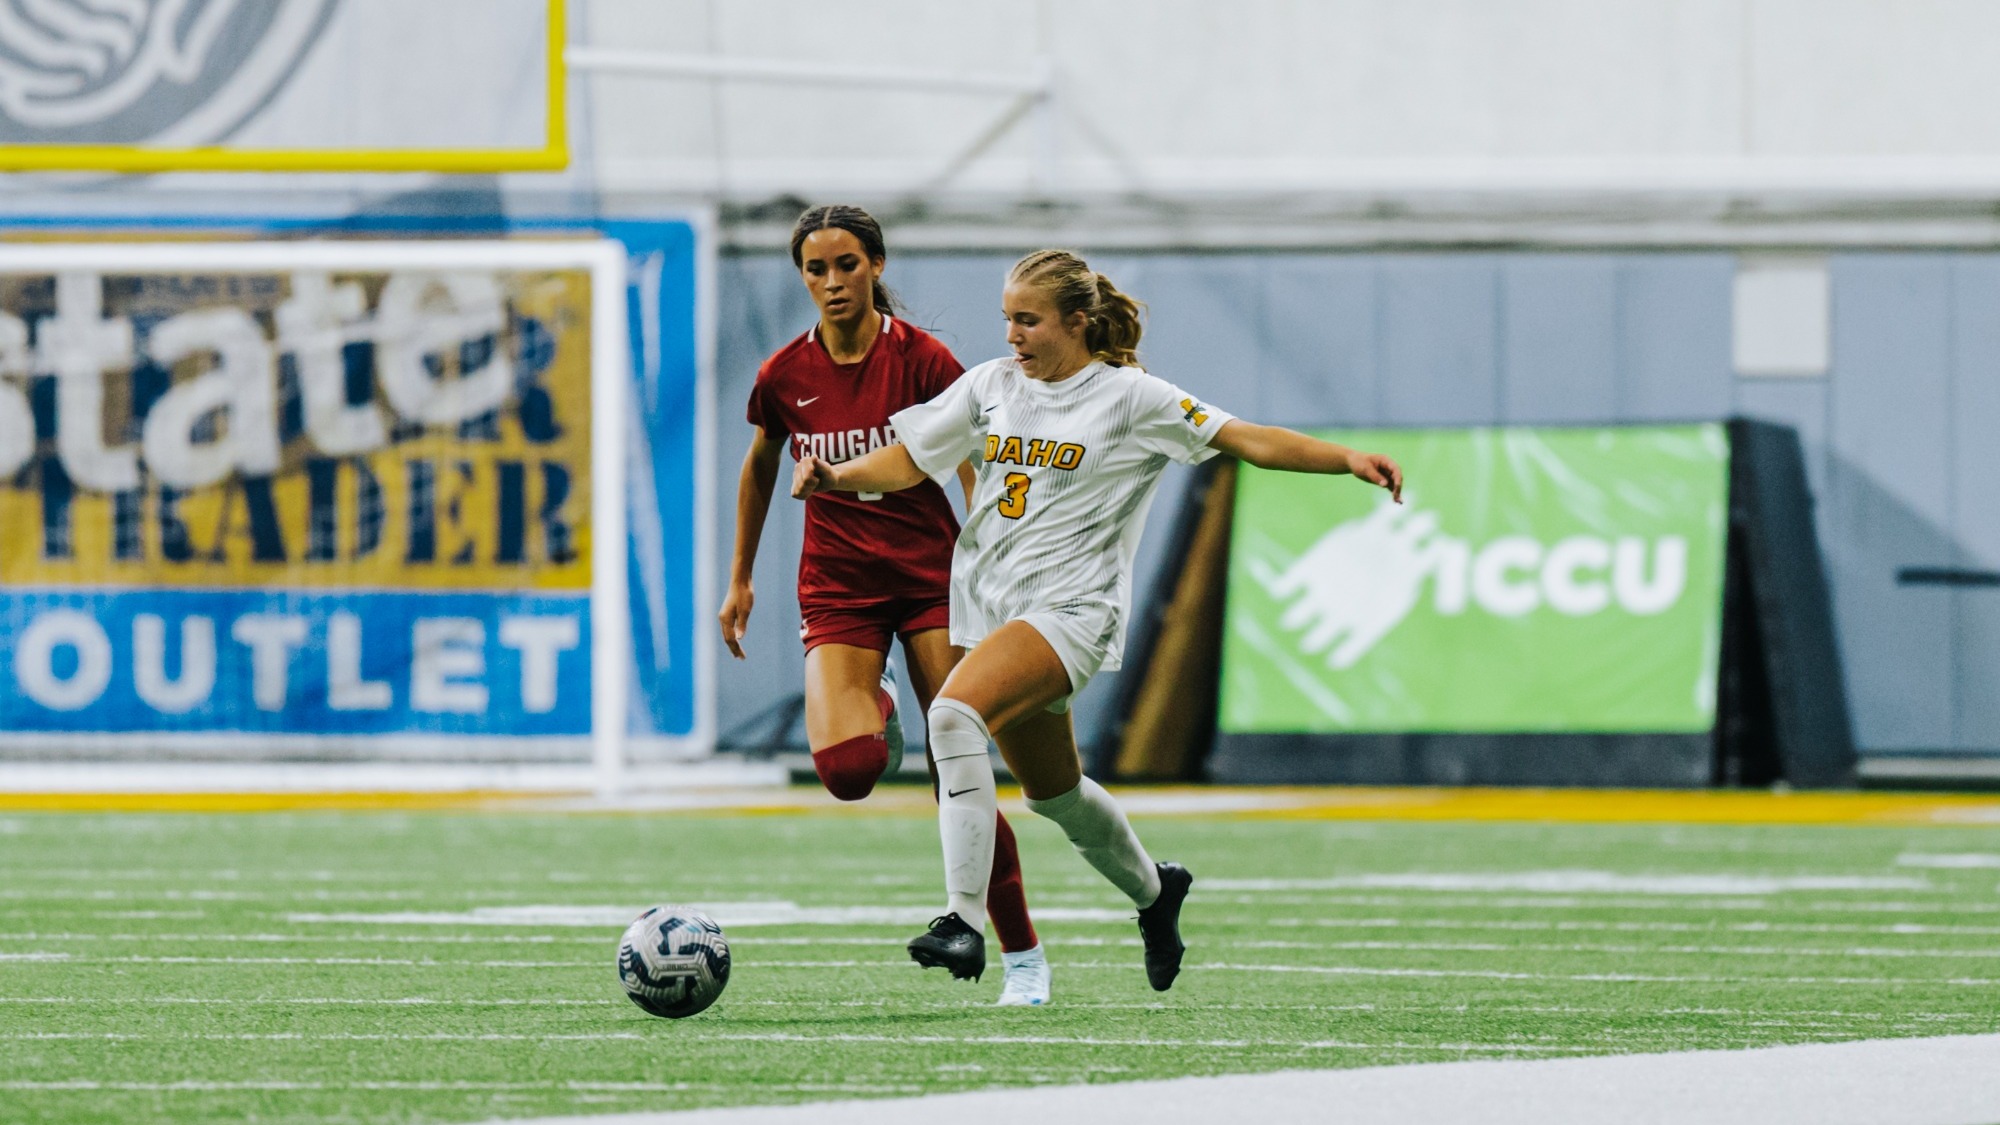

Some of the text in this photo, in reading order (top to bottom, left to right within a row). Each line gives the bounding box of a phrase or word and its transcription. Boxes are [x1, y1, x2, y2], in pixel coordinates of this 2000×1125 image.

[984, 434, 1086, 471] DAHO
[998, 472, 1031, 520] 3
[1431, 534, 1687, 617] ICCU
[15, 608, 580, 714] OUTLET
